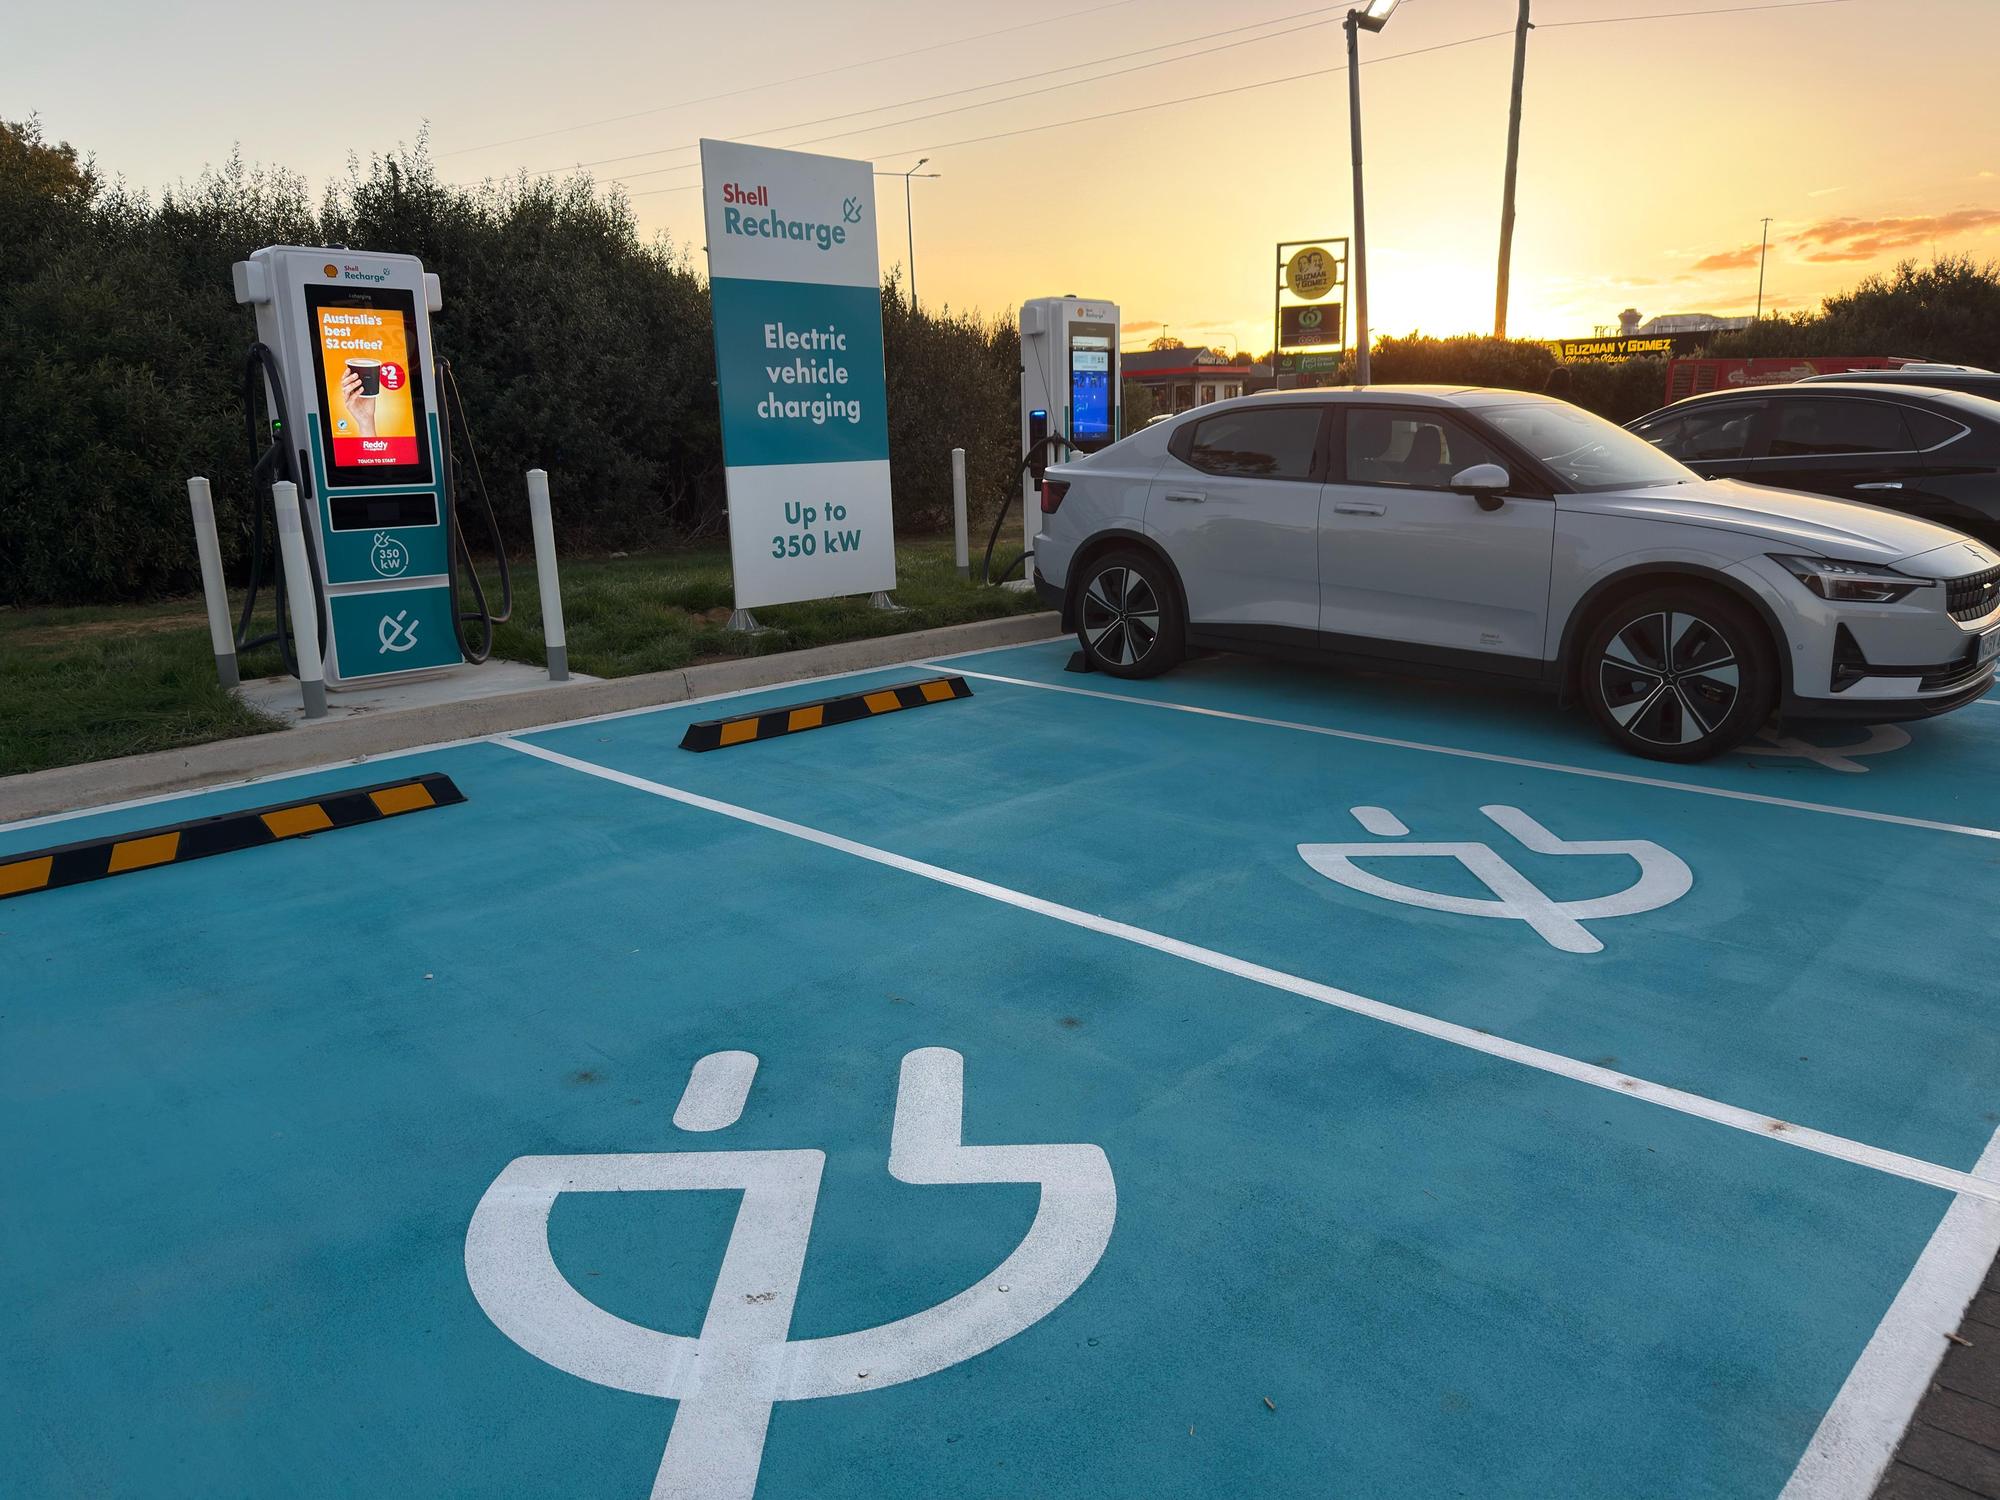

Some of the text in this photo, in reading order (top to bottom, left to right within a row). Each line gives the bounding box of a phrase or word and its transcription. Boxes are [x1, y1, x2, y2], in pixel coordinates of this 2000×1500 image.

[723, 183, 768, 206] Shell
[724, 207, 846, 250] Recharge
[344, 272, 385, 282] Recharge
[1295, 272, 1326, 281] GUZMAN
[1302, 279, 1328, 288] GOMEZ
[323, 313, 382, 325] Australia's
[324, 326, 351, 336] best
[764, 322, 846, 351] Electric
[326, 338, 383, 350] $2 coffee?
[1565, 339, 1671, 355] GUZMAN Y GOMEZ
[381, 365, 398, 380] $2
[766, 357, 848, 385] vehicle
[757, 392, 861, 424] charging
[363, 441, 388, 450] Reddy
[784, 501, 847, 530] Up to
[772, 529, 861, 559] 350 kW
[380, 549, 400, 559] 350
[380, 559, 400, 569] kW
